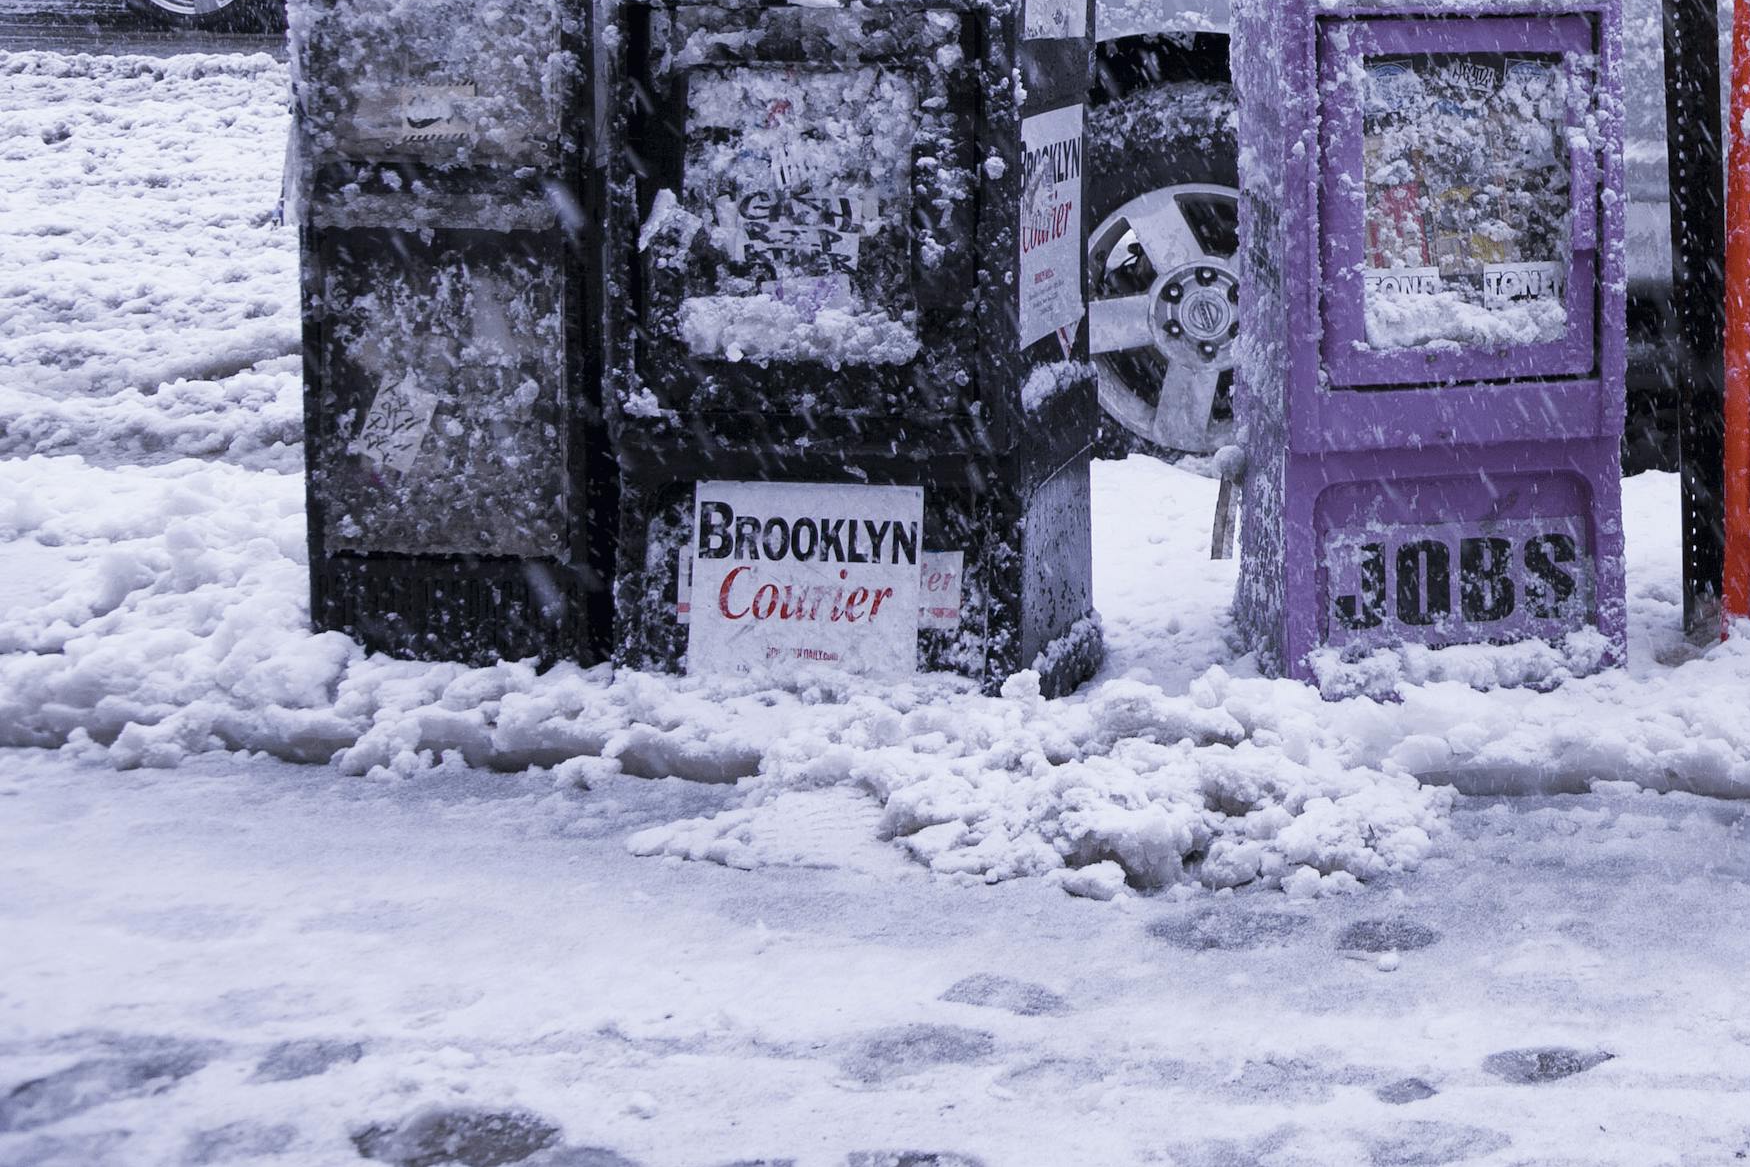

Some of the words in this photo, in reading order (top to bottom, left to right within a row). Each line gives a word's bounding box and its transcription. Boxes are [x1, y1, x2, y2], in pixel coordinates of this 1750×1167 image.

[1021, 137, 1081, 191] BROKLYN
[698, 501, 919, 566] BROOKLYN
[718, 566, 894, 624] Courier
[1335, 533, 1577, 631] JOBS
